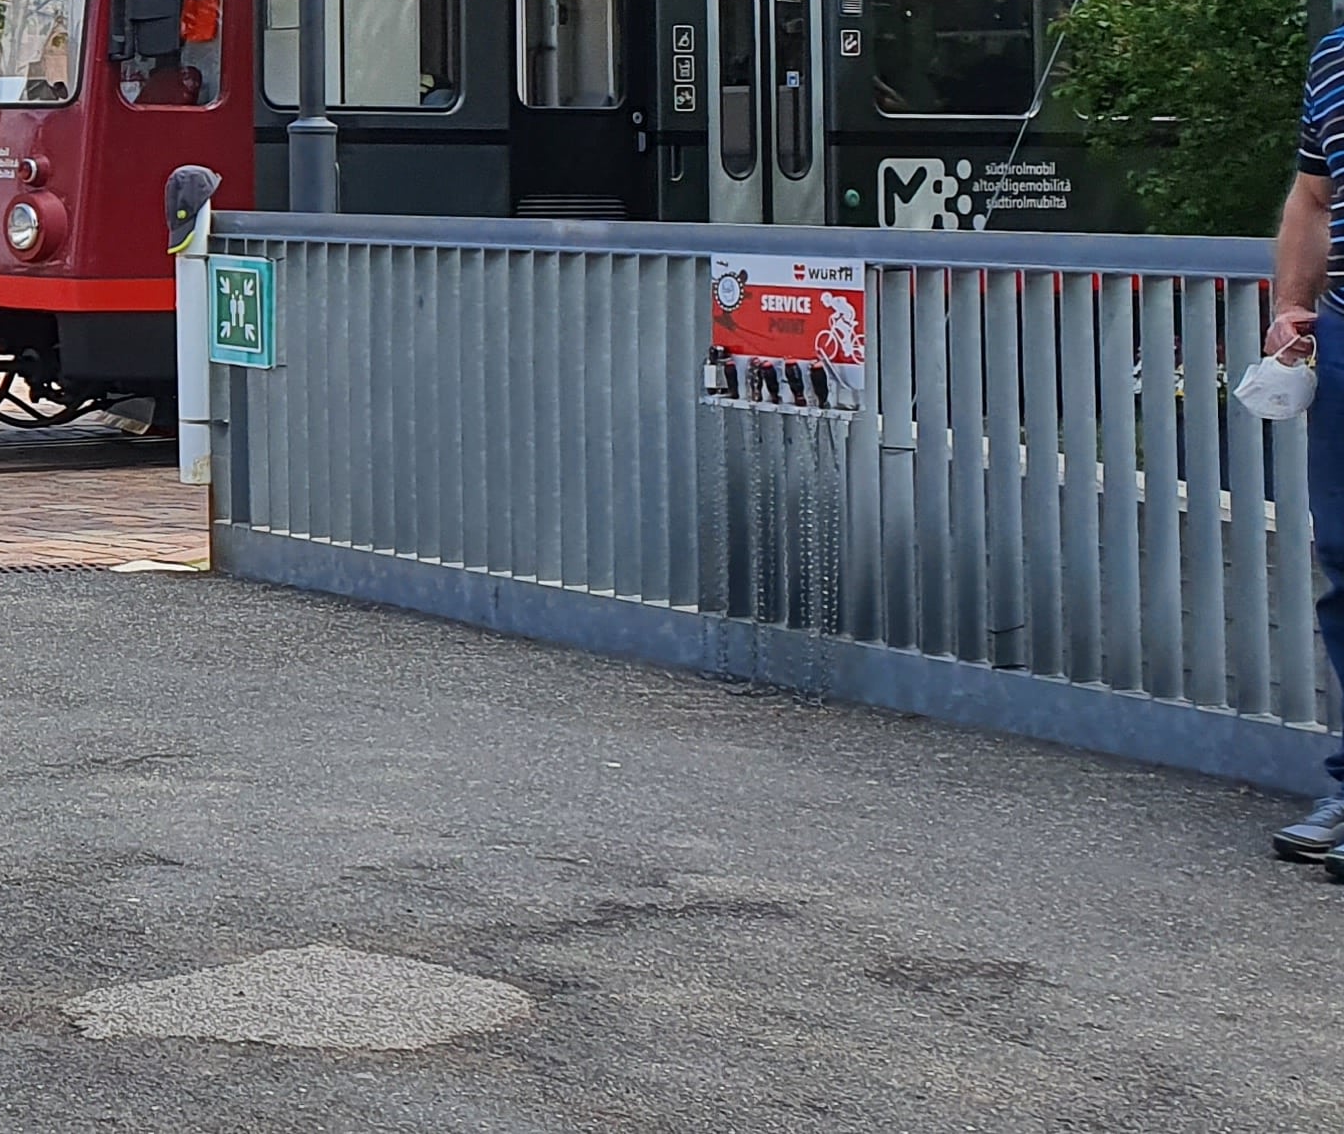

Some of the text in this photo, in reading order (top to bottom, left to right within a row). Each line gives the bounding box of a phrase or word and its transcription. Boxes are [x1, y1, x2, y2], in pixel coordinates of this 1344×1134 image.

[985, 161, 1056, 175] südtirolmobil
[972, 178, 1072, 195] altoadigemobilità
[760, 294, 812, 314] SERVICE
